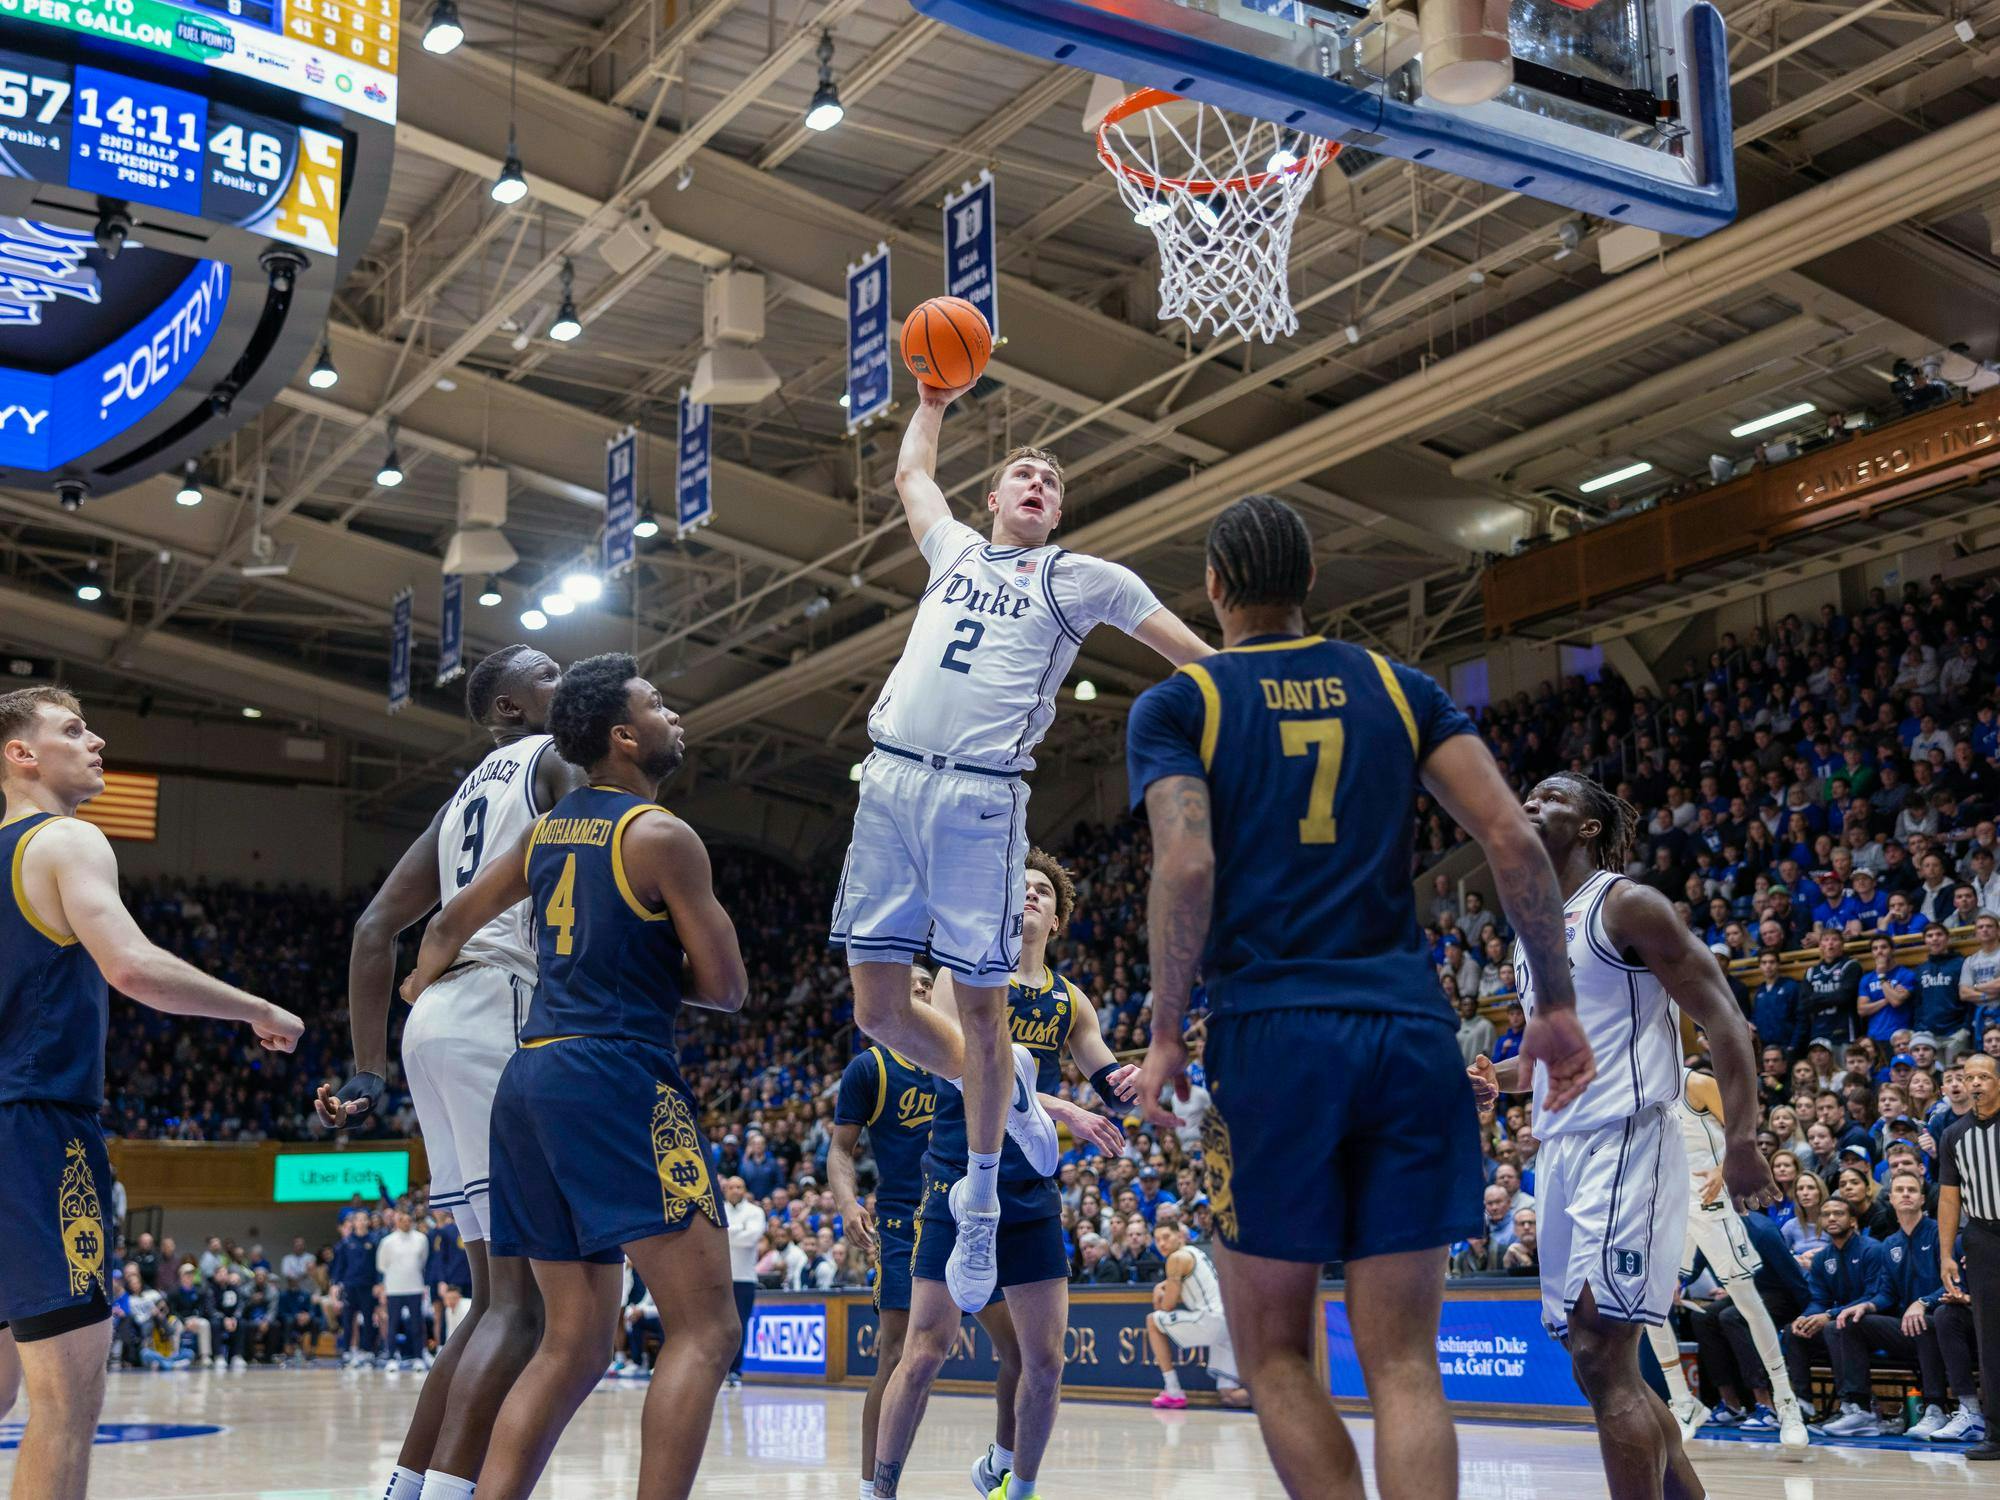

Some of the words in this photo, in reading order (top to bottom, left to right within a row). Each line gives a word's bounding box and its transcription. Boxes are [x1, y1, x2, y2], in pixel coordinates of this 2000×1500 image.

[23, 0, 71, 24] PER
[74, 7, 173, 49] GALLON
[177, 23, 200, 43] FUEL
[200, 29, 234, 53] POINTS
[0, 68, 71, 124] 57
[78, 88, 201, 153] 14:11
[49, 136, 61, 151] 4
[136, 142, 179, 163] HALF
[208, 123, 282, 181] 46
[79, 143, 91, 158] 3
[97, 147, 179, 178] TIMEOUTS
[184, 168, 195, 183] 3
[117, 166, 158, 188] POSS
[212, 168, 256, 194] Fouls:
[1795, 439, 1931, 503] CAMERON
[1940, 416, 2000, 456] IND
[941, 572, 1032, 619] Duke
[939, 618, 986, 675] 2
[1259, 677, 1347, 710] DAVIS
[456, 759, 520, 807] MALUACH
[1279, 717, 1345, 845] 7
[456, 795, 489, 888] 9
[536, 818, 613, 847] MOHAMMED
[546, 853, 576, 955] 4
[1921, 972, 1952, 989] Duke
[301, 1168, 338, 1185] Uber
[763, 1321, 822, 1357] NEWS
[1437, 1335, 1494, 1357] ashington
[1495, 1336, 1529, 1354] Duke
[1454, 1357, 1466, 1375] &
[1466, 1357, 1494, 1376] Golf
